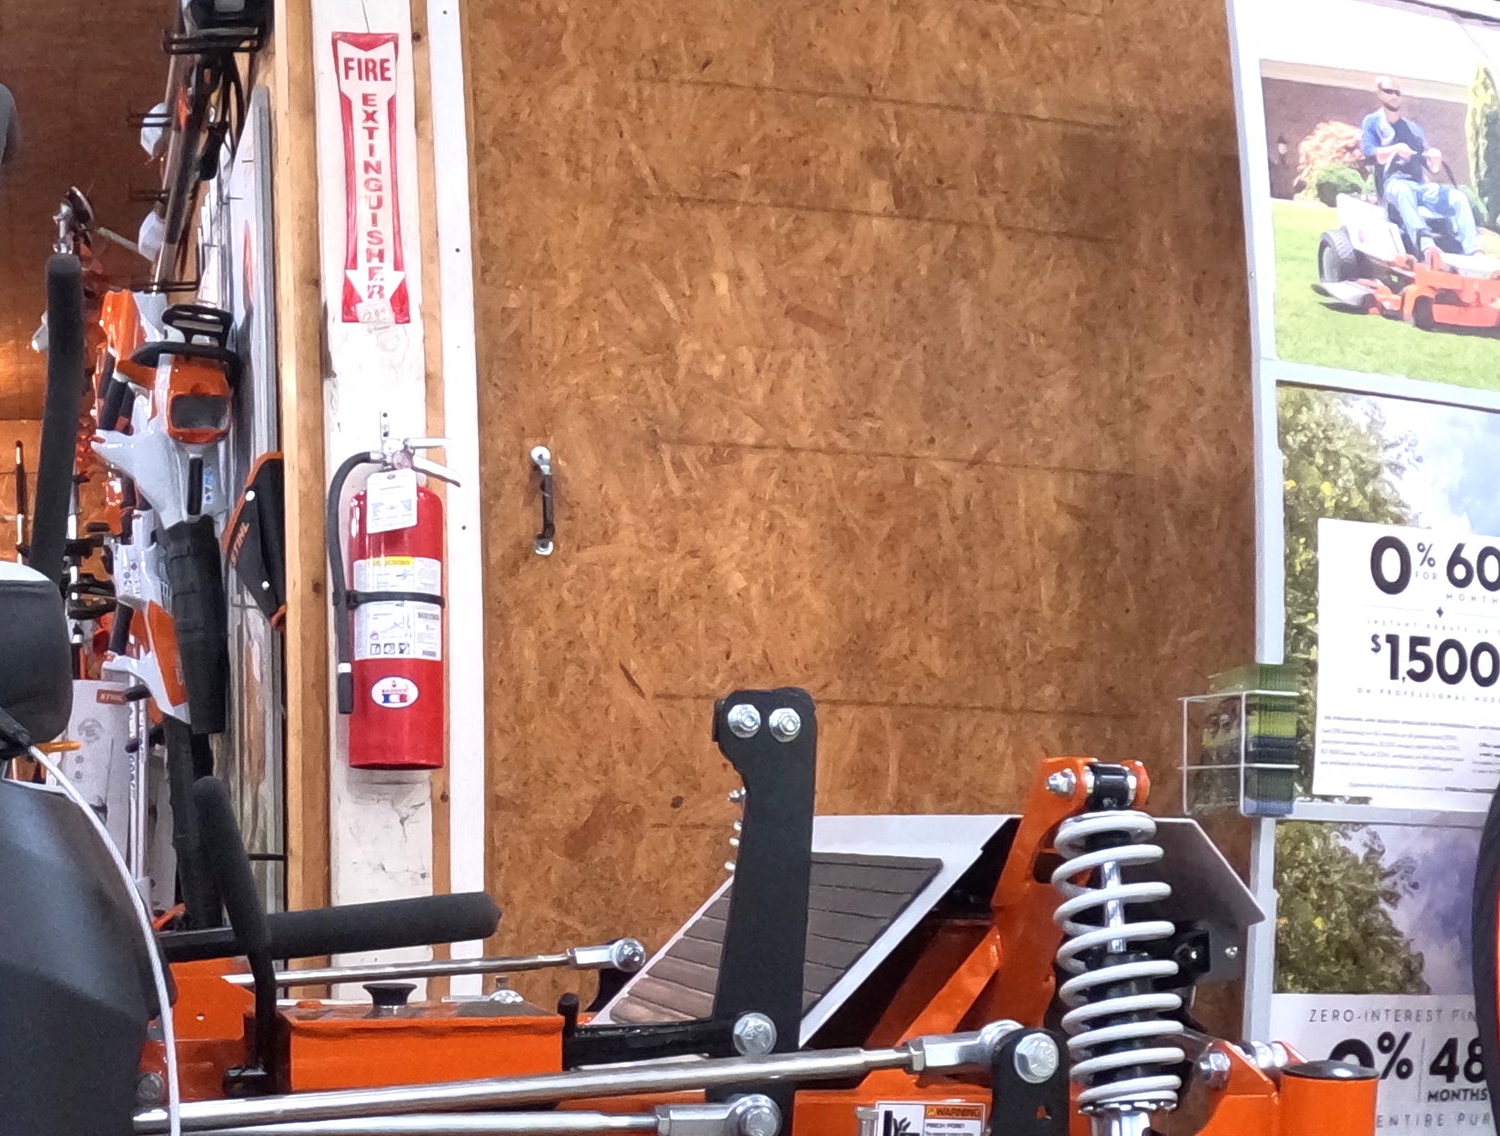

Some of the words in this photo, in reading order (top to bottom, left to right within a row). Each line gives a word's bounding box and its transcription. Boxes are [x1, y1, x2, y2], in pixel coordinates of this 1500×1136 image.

[343, 56, 392, 82] FIRE
[361, 92, 386, 299] EXTINGUISHER
[1446, 542, 1500, 592] 60
[1429, 1037, 1487, 1084] 48
[1427, 1087, 1489, 1103] MONTHS
